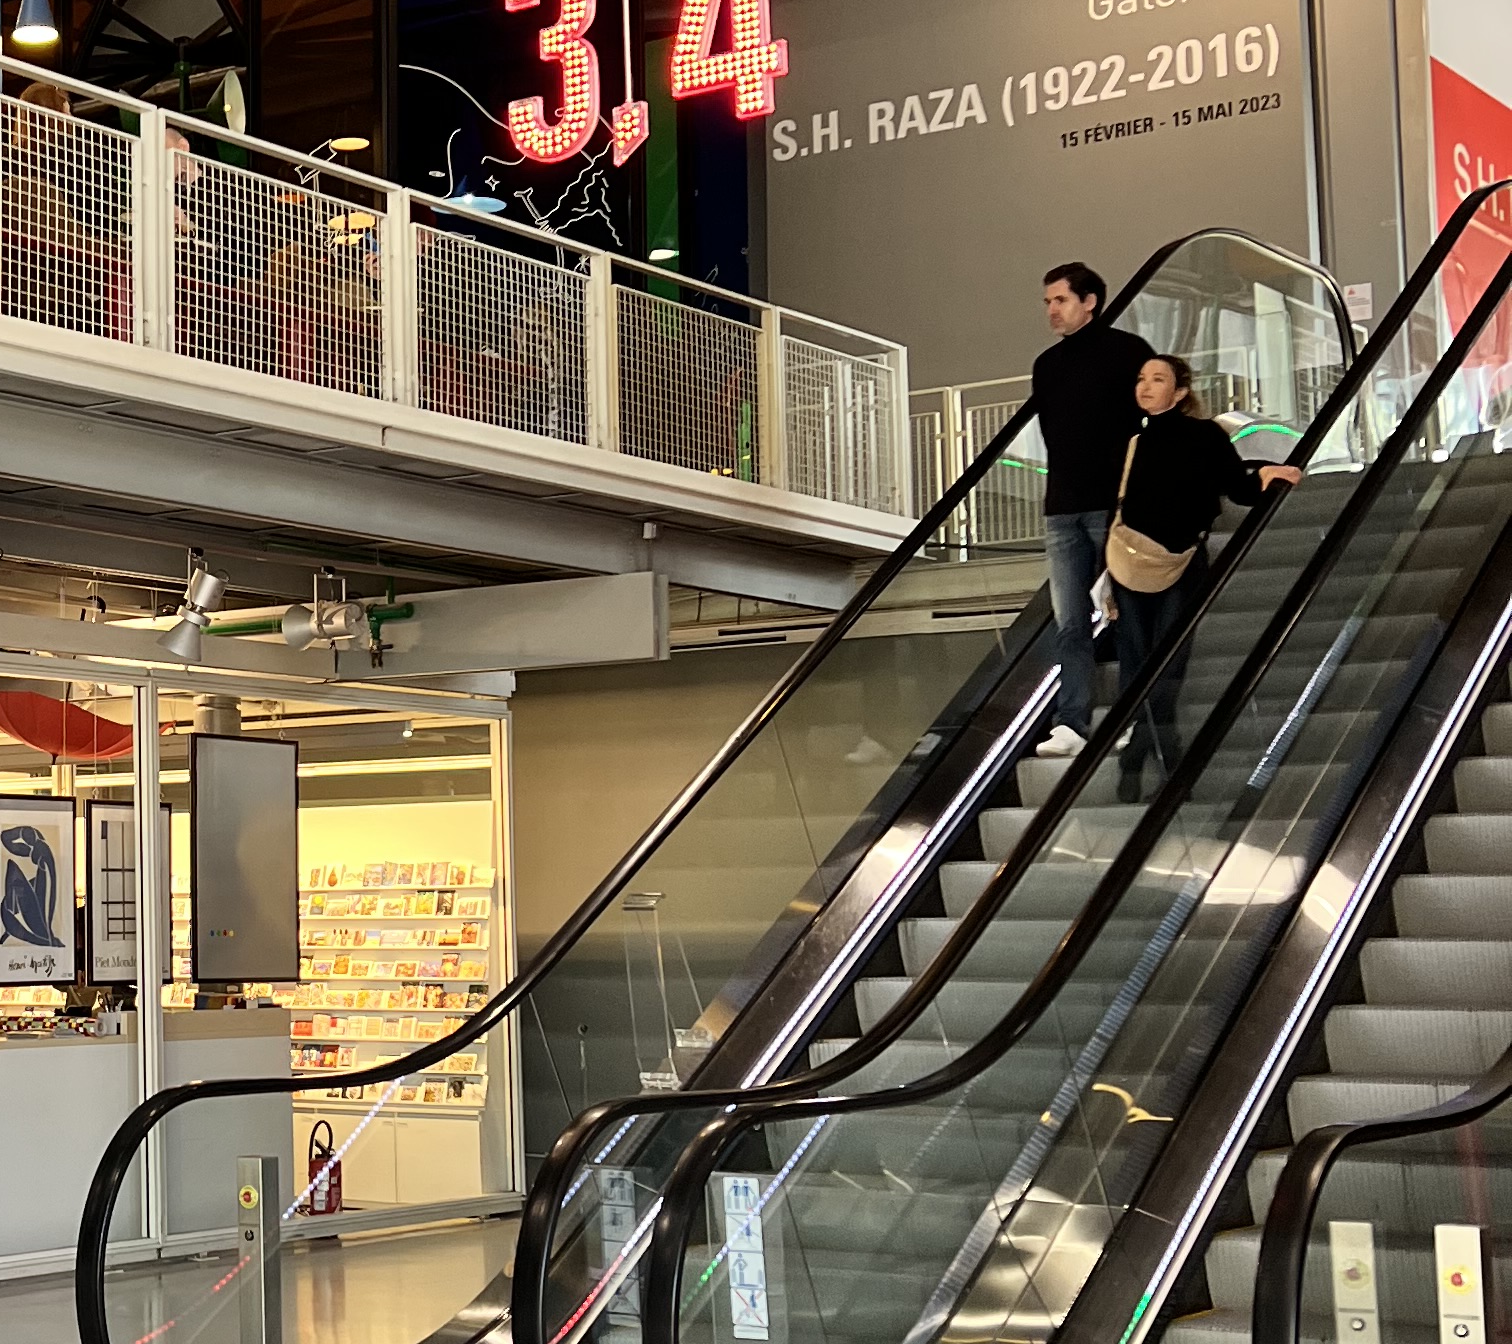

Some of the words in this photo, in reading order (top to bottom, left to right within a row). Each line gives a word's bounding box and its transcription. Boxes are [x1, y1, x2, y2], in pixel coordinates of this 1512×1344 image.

[772, 110, 852, 161] S.H.
[868, 83, 987, 144] RAZA
[1001, 23, 1279, 127] (1922-2016)
[1060, 130, 1079, 149] 15
[1085, 116, 1154, 145] FÉVRIER
[1172, 109, 1192, 128] 15
[1197, 101, 1233, 123] MAI
[1238, 92, 1281, 116] 2023
